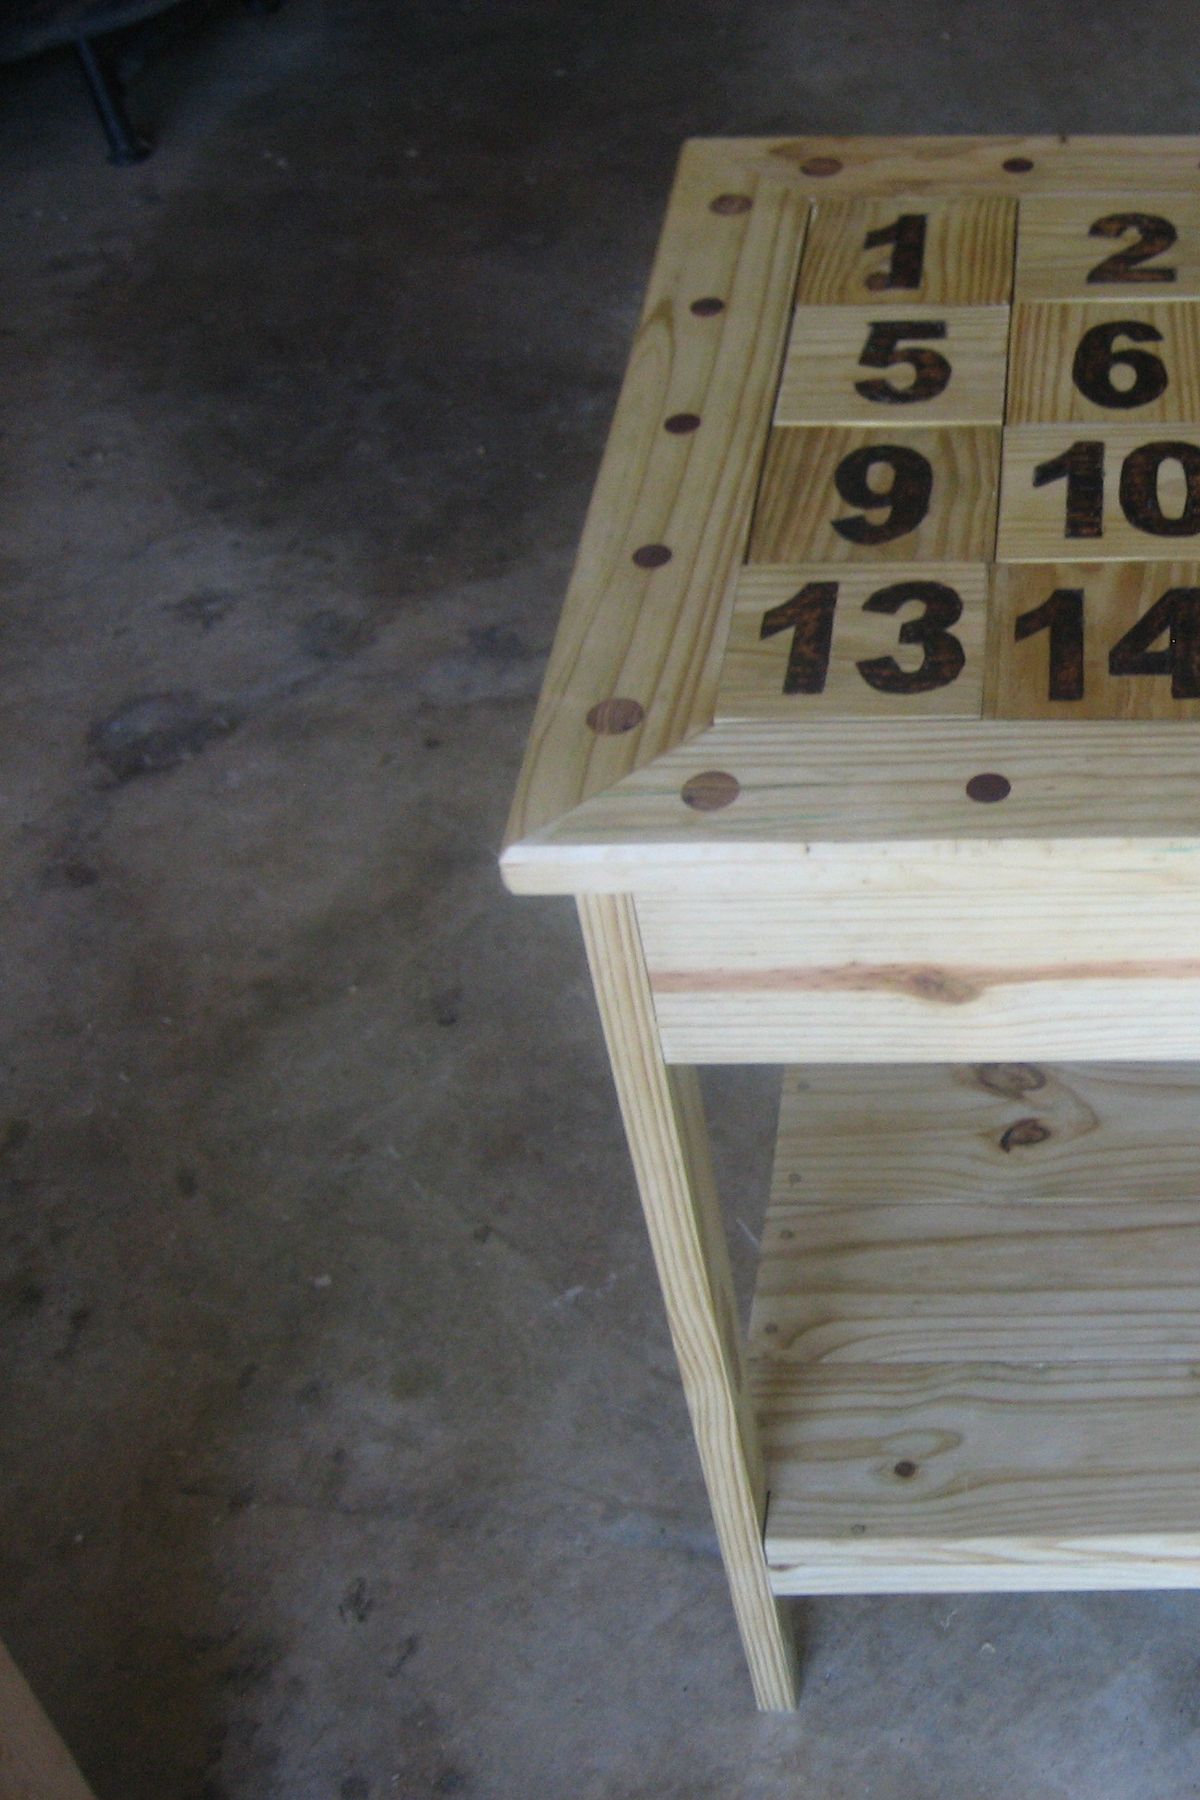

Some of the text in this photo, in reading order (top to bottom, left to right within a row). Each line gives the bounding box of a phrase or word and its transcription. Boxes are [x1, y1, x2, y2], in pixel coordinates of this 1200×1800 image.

[864, 212, 928, 290] 1
[1085, 212, 1178, 285] 2
[854, 319, 954, 405] 5
[1071, 320, 1169, 408] 6
[830, 445, 935, 545] 9
[760, 580, 968, 695] 13
